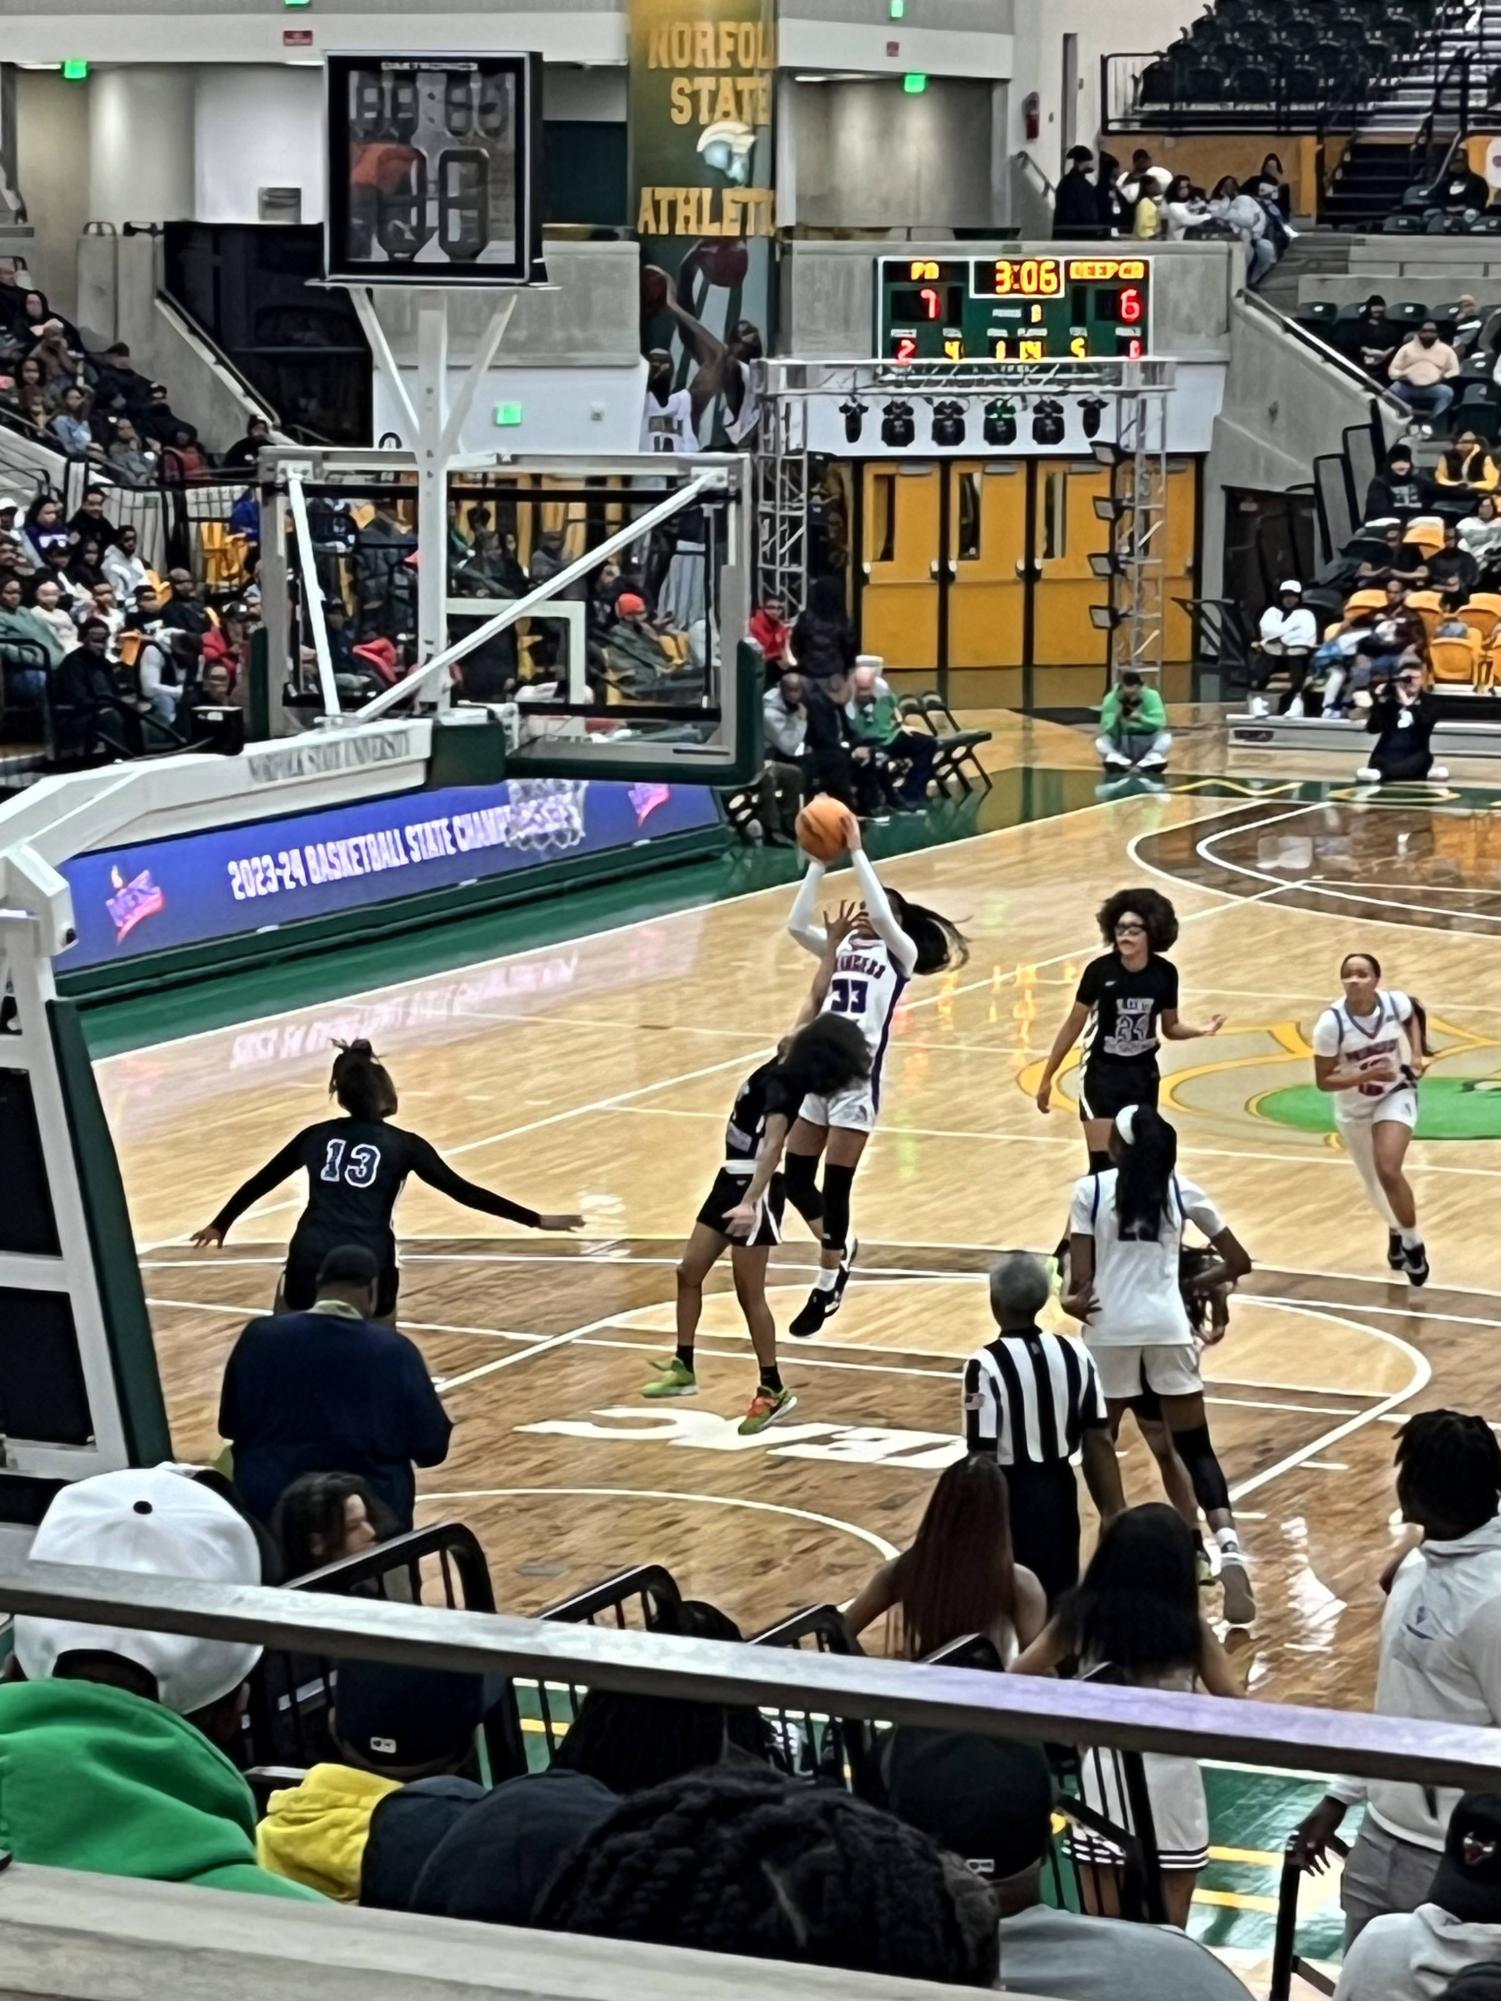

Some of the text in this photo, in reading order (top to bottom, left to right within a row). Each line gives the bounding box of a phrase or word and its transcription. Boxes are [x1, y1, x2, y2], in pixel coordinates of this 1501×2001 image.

[994, 260, 1059, 294] 3:06
[920, 288, 938, 319] 7
[1119, 288, 1141, 321] 6
[227, 848, 308, 901] 2023-24
[304, 828, 410, 885] BASKETBALL
[404, 816, 458, 864] STATE
[829, 977, 870, 1014] 33
[320, 1138, 381, 1188] 13
